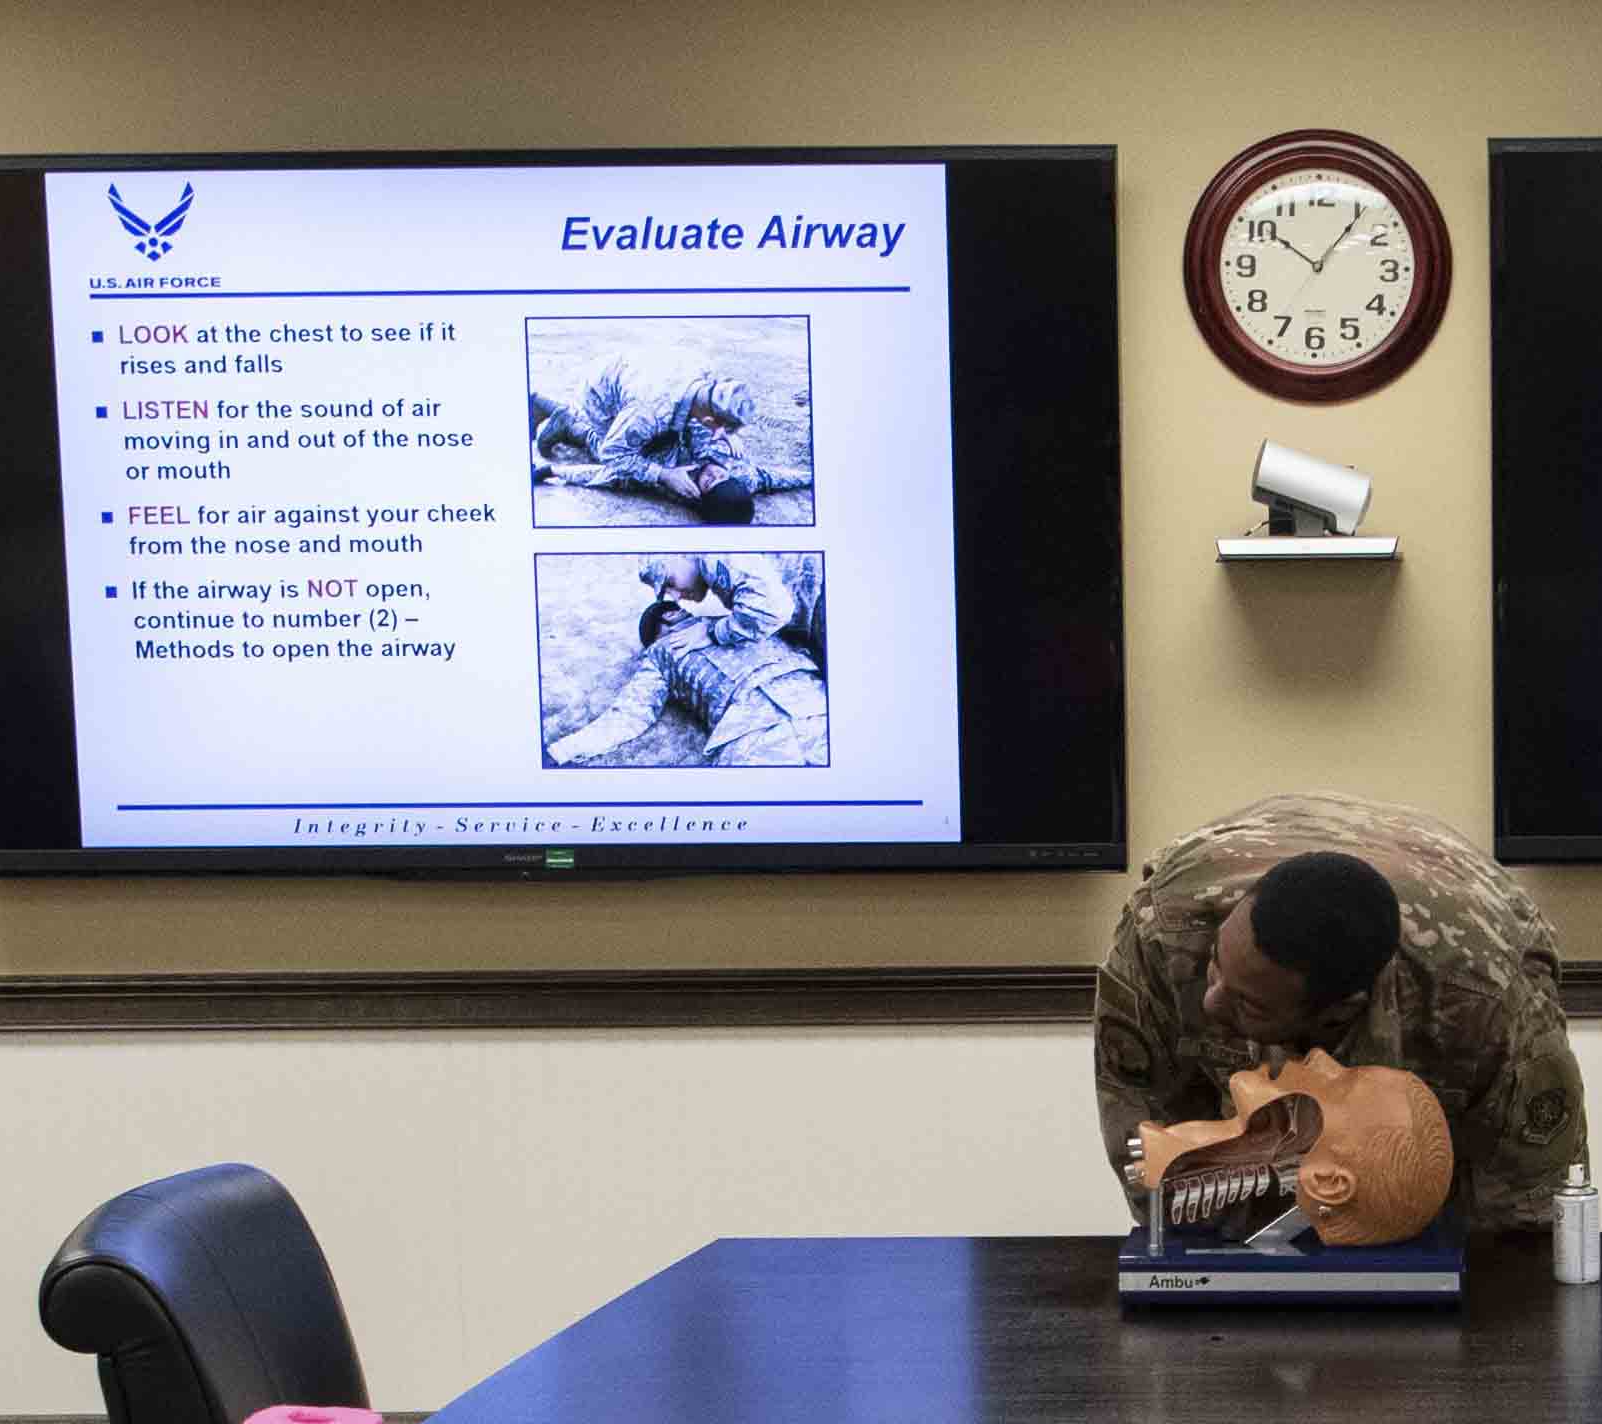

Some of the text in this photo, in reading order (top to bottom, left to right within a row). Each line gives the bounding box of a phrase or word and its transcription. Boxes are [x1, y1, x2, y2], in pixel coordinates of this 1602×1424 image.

[561, 214, 906, 258] Evaluate Airway
[1247, 219, 1278, 243] 10
[1370, 223, 1390, 247] 2
[1236, 253, 1257, 279] 9
[1379, 258, 1400, 283] 3
[89, 276, 221, 289] U.S. AIR FORCE
[1247, 289, 1268, 313] 8
[1365, 293, 1387, 316] 4
[119, 322, 455, 345] LOOK at the chest to see if it
[1273, 314, 1293, 337] 7
[1339, 316, 1361, 341] 5
[1304, 326, 1326, 351] 6
[120, 353, 283, 375] rises and falls
[123, 398, 441, 420] LISTEN for the sound of air
[124, 428, 474, 454] moving in and out of the nose
[125, 460, 231, 481] or mouth
[128, 503, 495, 529] FEEL for air against your cheek
[129, 533, 423, 555] from the nose and mouth
[132, 579, 430, 604] If the airway is NOT open,
[133, 610, 235, 630] continue
[242, 611, 265, 629] to
[273, 608, 362, 628] number
[369, 608, 398, 632] (2)
[135, 638, 456, 663] Methods to open the airway
[293, 818, 426, 837] Integrity
[455, 816, 561, 833] Service
[591, 815, 748, 833] Excellence
[1148, 1274, 1195, 1289] Ambu
